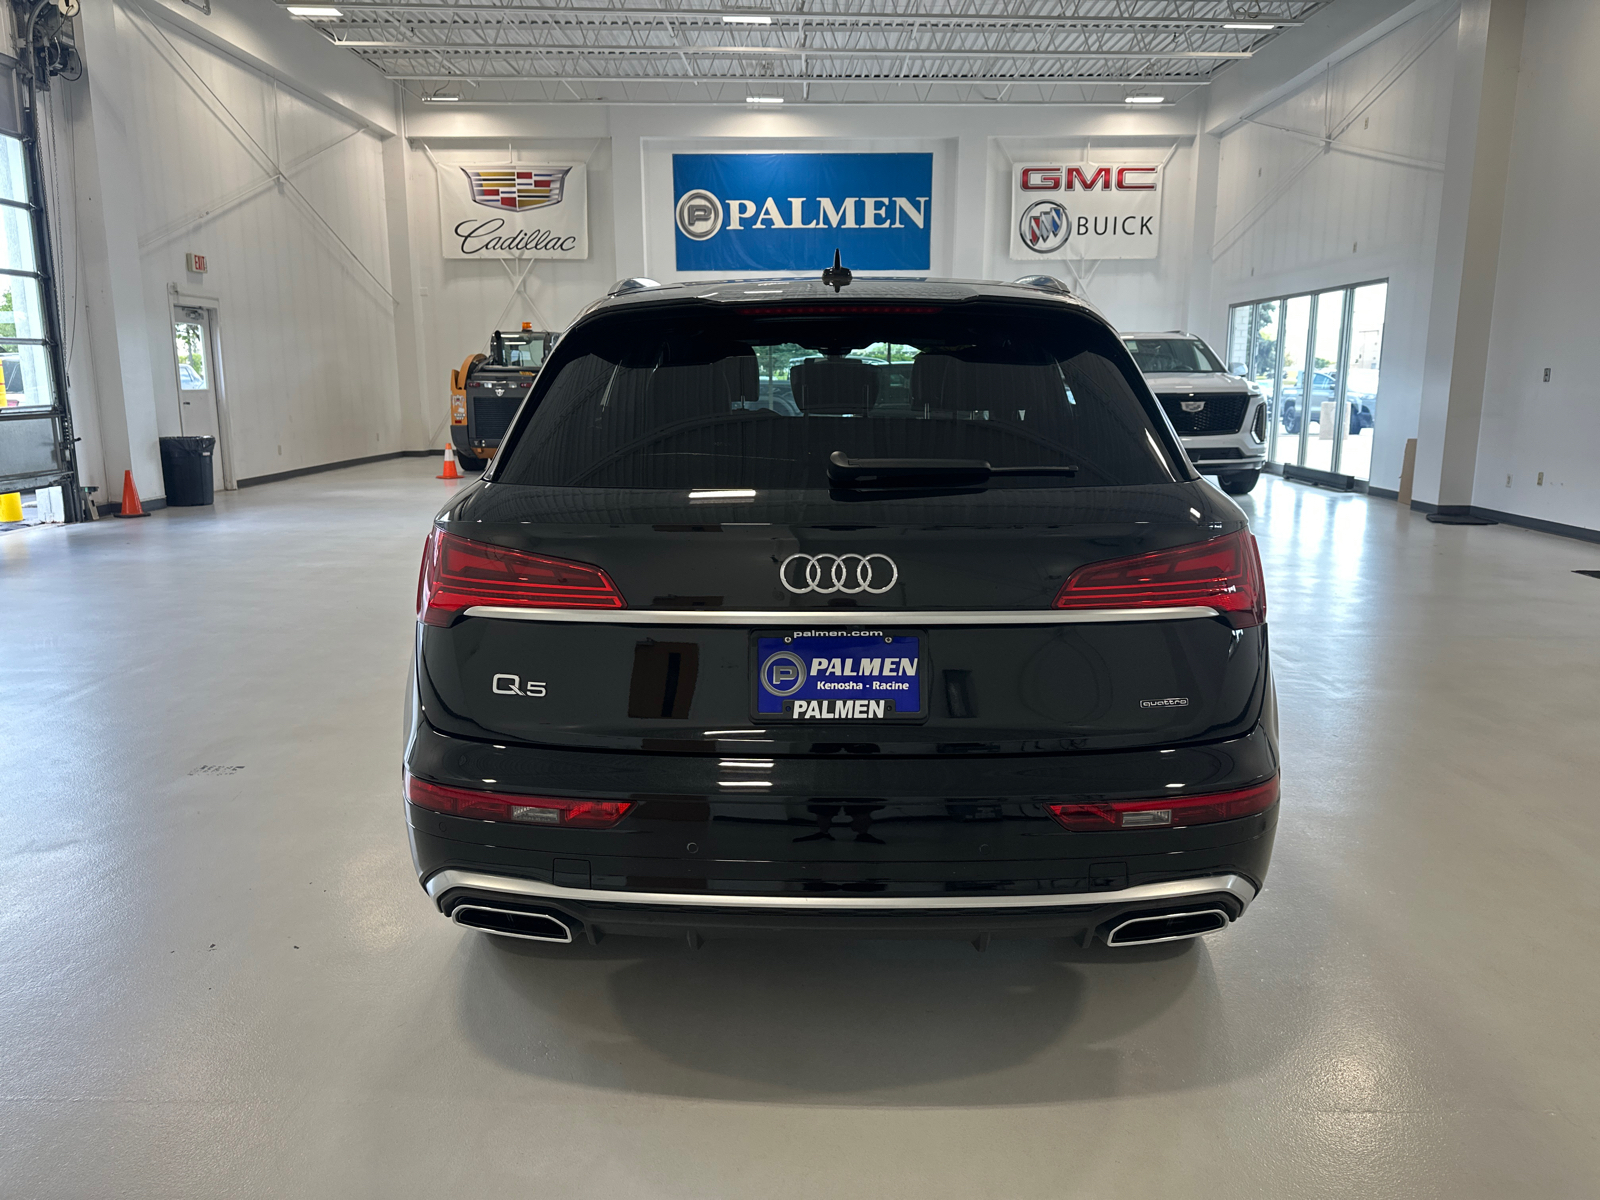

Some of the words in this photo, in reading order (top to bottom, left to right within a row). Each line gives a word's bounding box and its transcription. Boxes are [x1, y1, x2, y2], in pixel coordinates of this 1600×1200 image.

[1020, 166, 1157, 191] GMC
[725, 196, 929, 230] PALMEN
[1077, 216, 1153, 235] BUICK
[454, 218, 576, 254] Cadillac
[194, 254, 205, 271] EXIT
[793, 630, 883, 638] palmen.com
[809, 657, 918, 676] PALMEN
[492, 673, 546, 697] Q5
[817, 681, 863, 690] Kenosha
[872, 681, 909, 690] Racine
[793, 700, 885, 719] PALMEN
[1143, 699, 1187, 707] quattro
